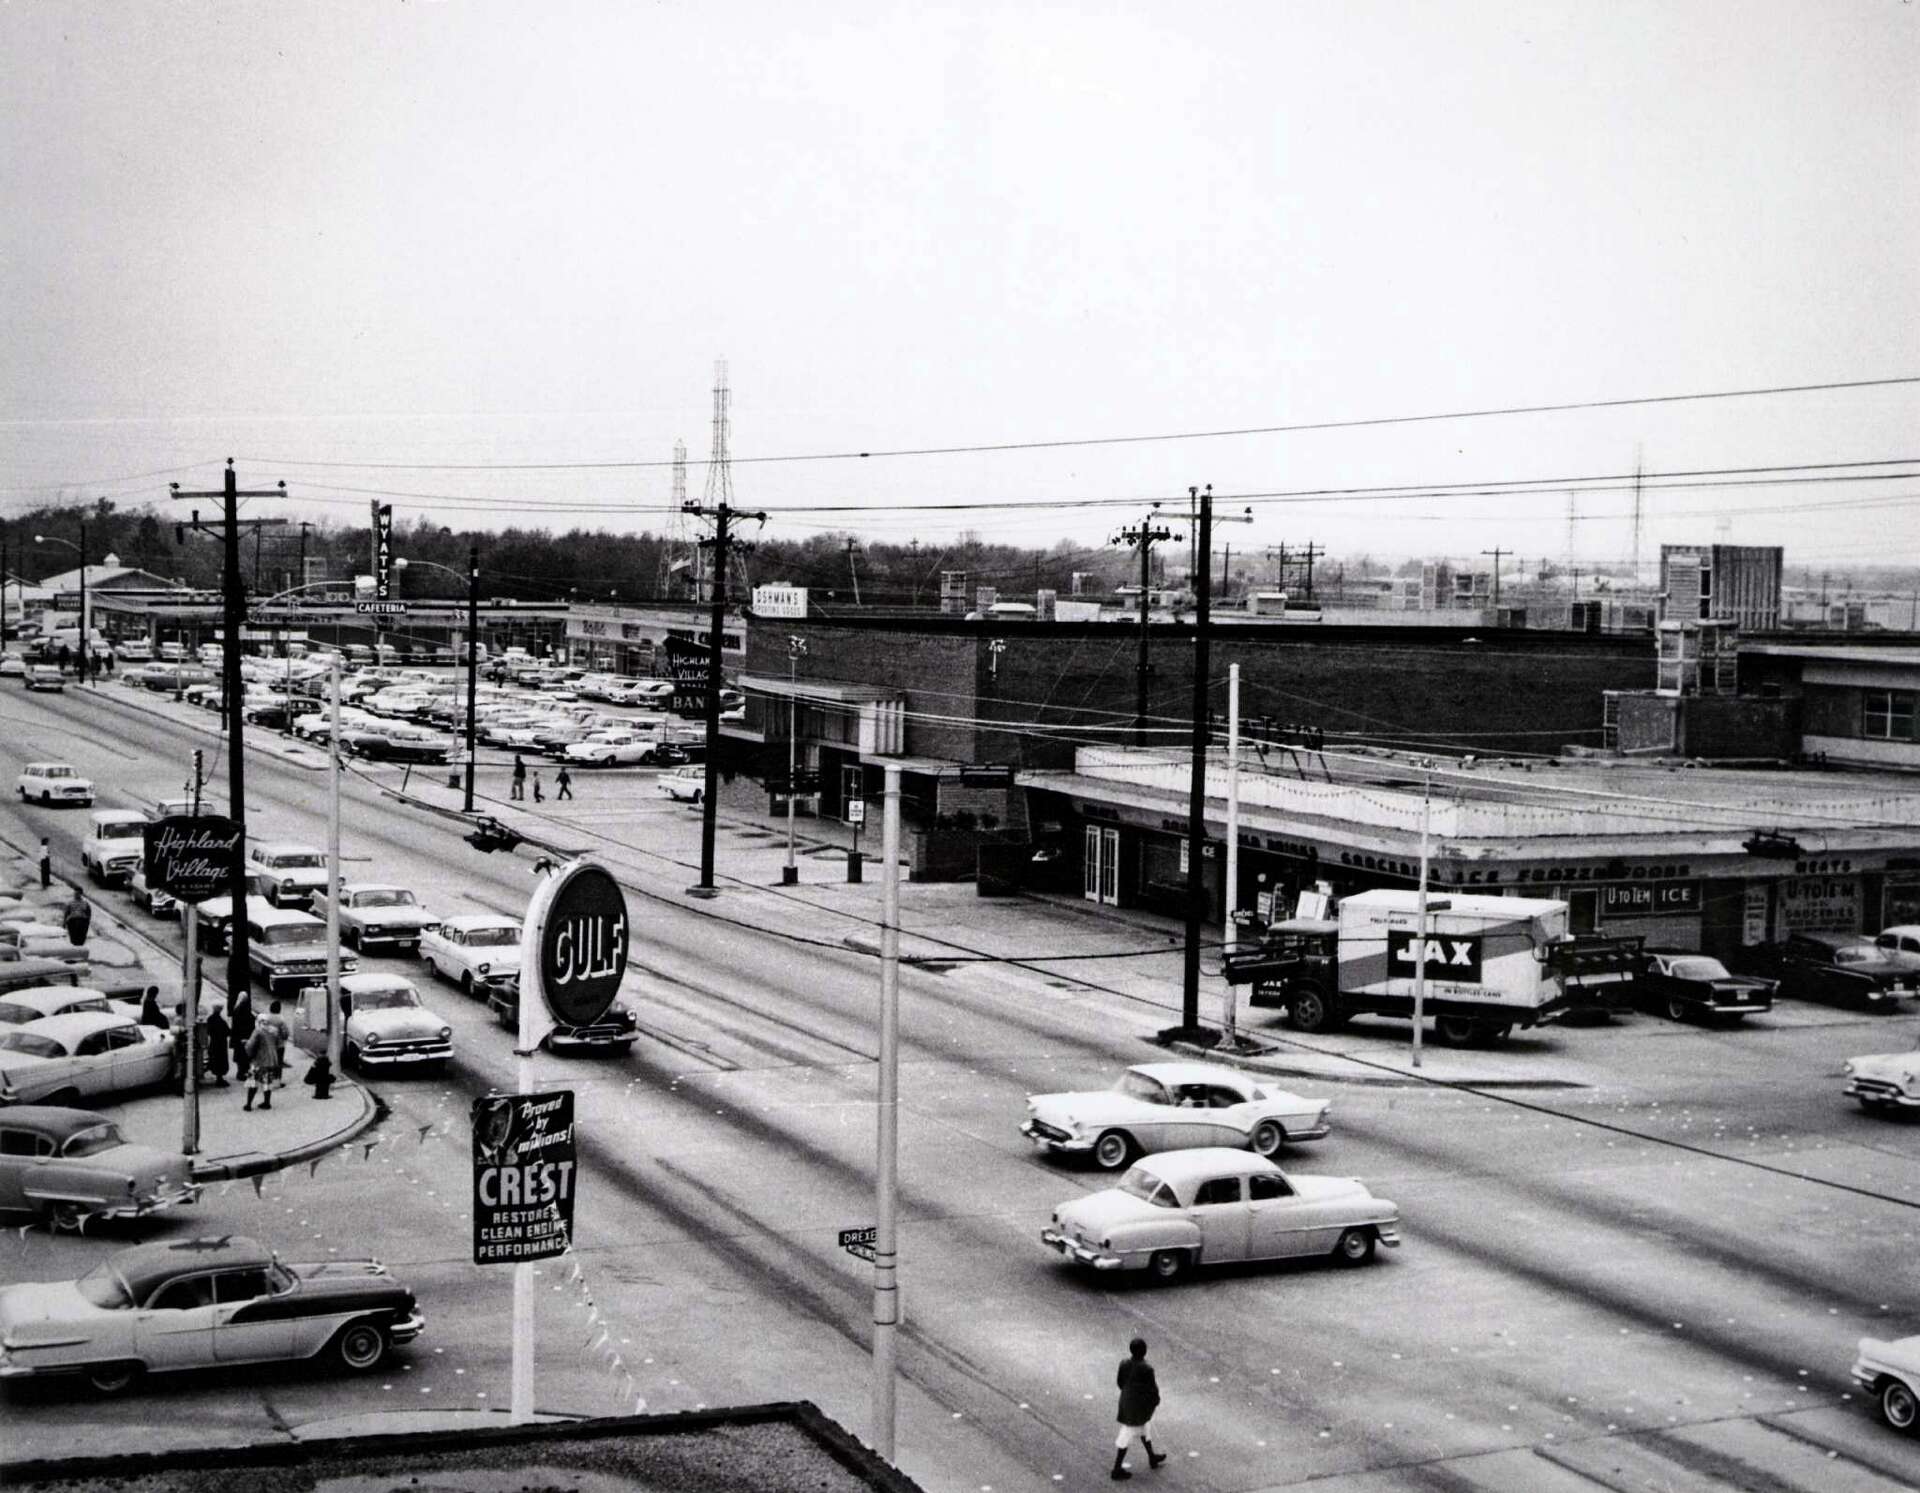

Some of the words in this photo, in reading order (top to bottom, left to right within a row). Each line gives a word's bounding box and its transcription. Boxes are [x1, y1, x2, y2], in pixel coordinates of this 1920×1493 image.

[378, 513, 391, 597] WYATT'S
[358, 602, 407, 613] CAFETERIA
[672, 652, 711, 668] HIGHLAN
[677, 668, 710, 681] VILLAG
[672, 695, 706, 709] BAN
[153, 826, 241, 864] Highland
[166, 855, 230, 882] Village
[1340, 851, 1440, 881] GROCERIS
[1661, 887, 1692, 903] ICE
[554, 912, 625, 985] GULF
[1396, 938, 1473, 966] JAX
[521, 1094, 564, 1119] Proved
[535, 1115, 550, 1131] by
[479, 1160, 574, 1206] CREST
[481, 1226, 522, 1240] CLEAN
[526, 1219, 568, 1237] ENGINE
[844, 1230, 877, 1244] DREXE
